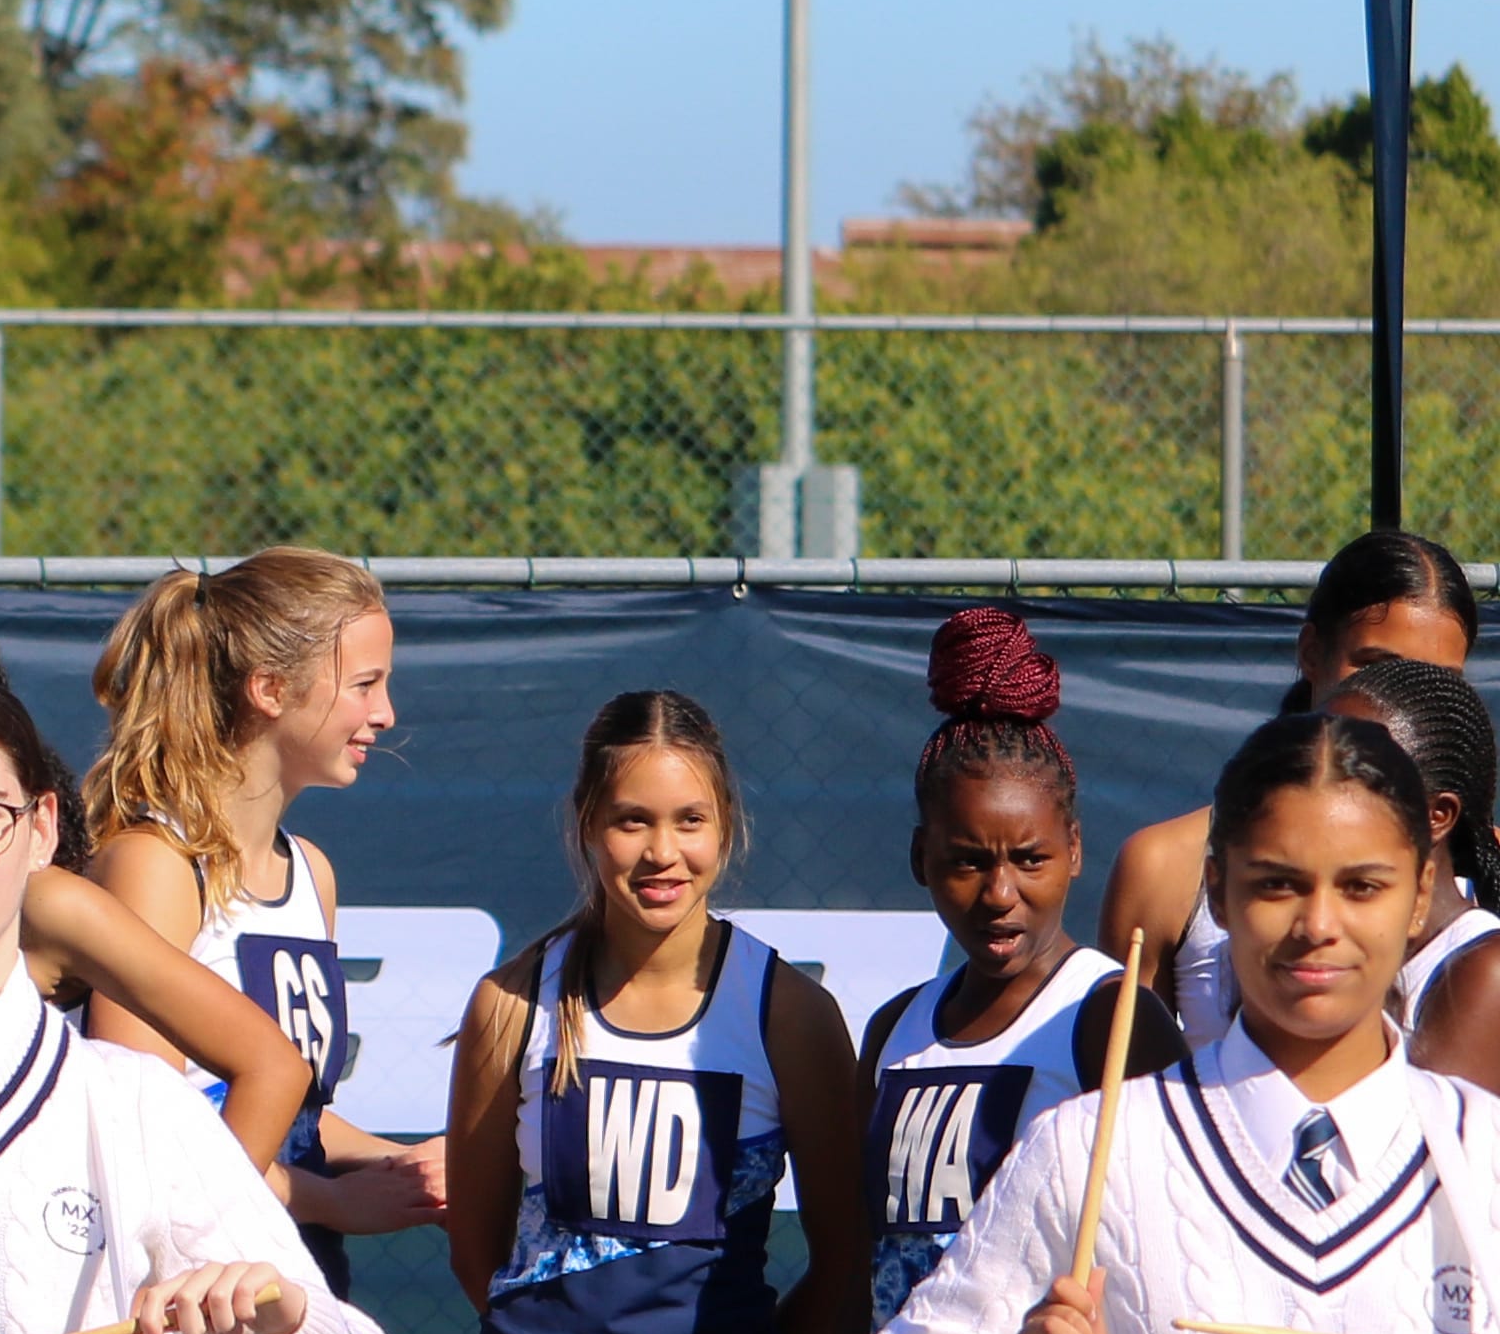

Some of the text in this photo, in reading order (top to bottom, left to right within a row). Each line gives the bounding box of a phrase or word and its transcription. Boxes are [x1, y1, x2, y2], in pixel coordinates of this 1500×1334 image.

[273, 949, 333, 1091] GS
[62, 1200, 96, 1224] MX
[587, 1076, 700, 1226] WD
[886, 1082, 983, 1223] WA
[1442, 1282, 1474, 1304] MX
